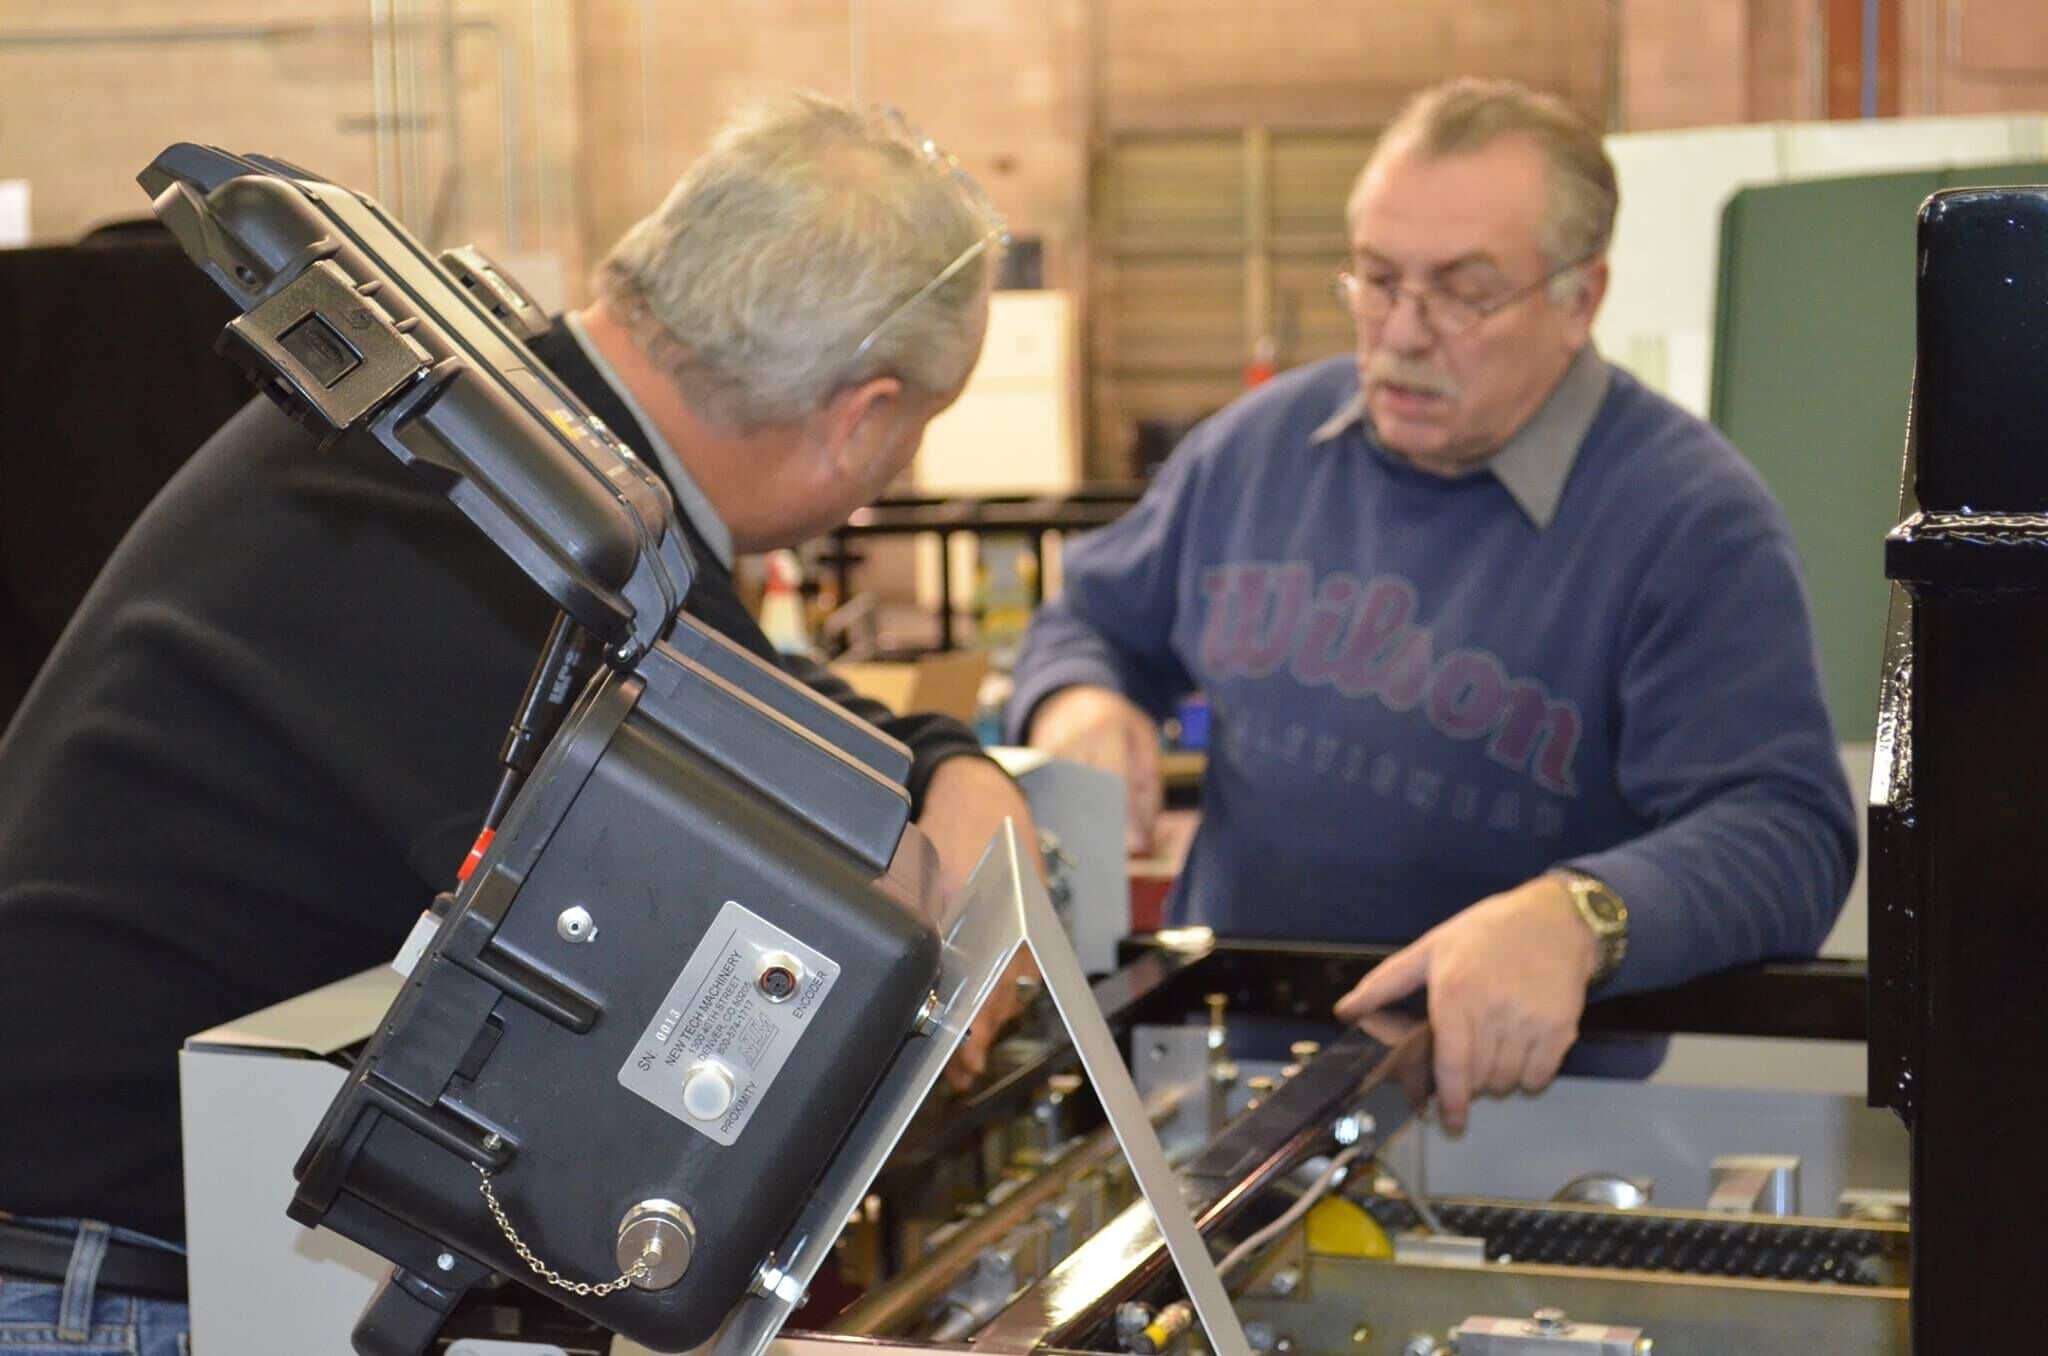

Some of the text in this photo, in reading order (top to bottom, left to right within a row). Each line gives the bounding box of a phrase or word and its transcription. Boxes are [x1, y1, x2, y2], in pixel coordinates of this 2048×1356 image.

[1201, 561, 1583, 798] Wilson
[663, 948, 743, 1067] NEW TECH MACHINERY
[714, 974, 742, 1011] STREET
[721, 1005, 737, 1023] CO
[792, 969, 827, 1019] ENCODER
[720, 1080, 759, 1134] PROXIMITY
